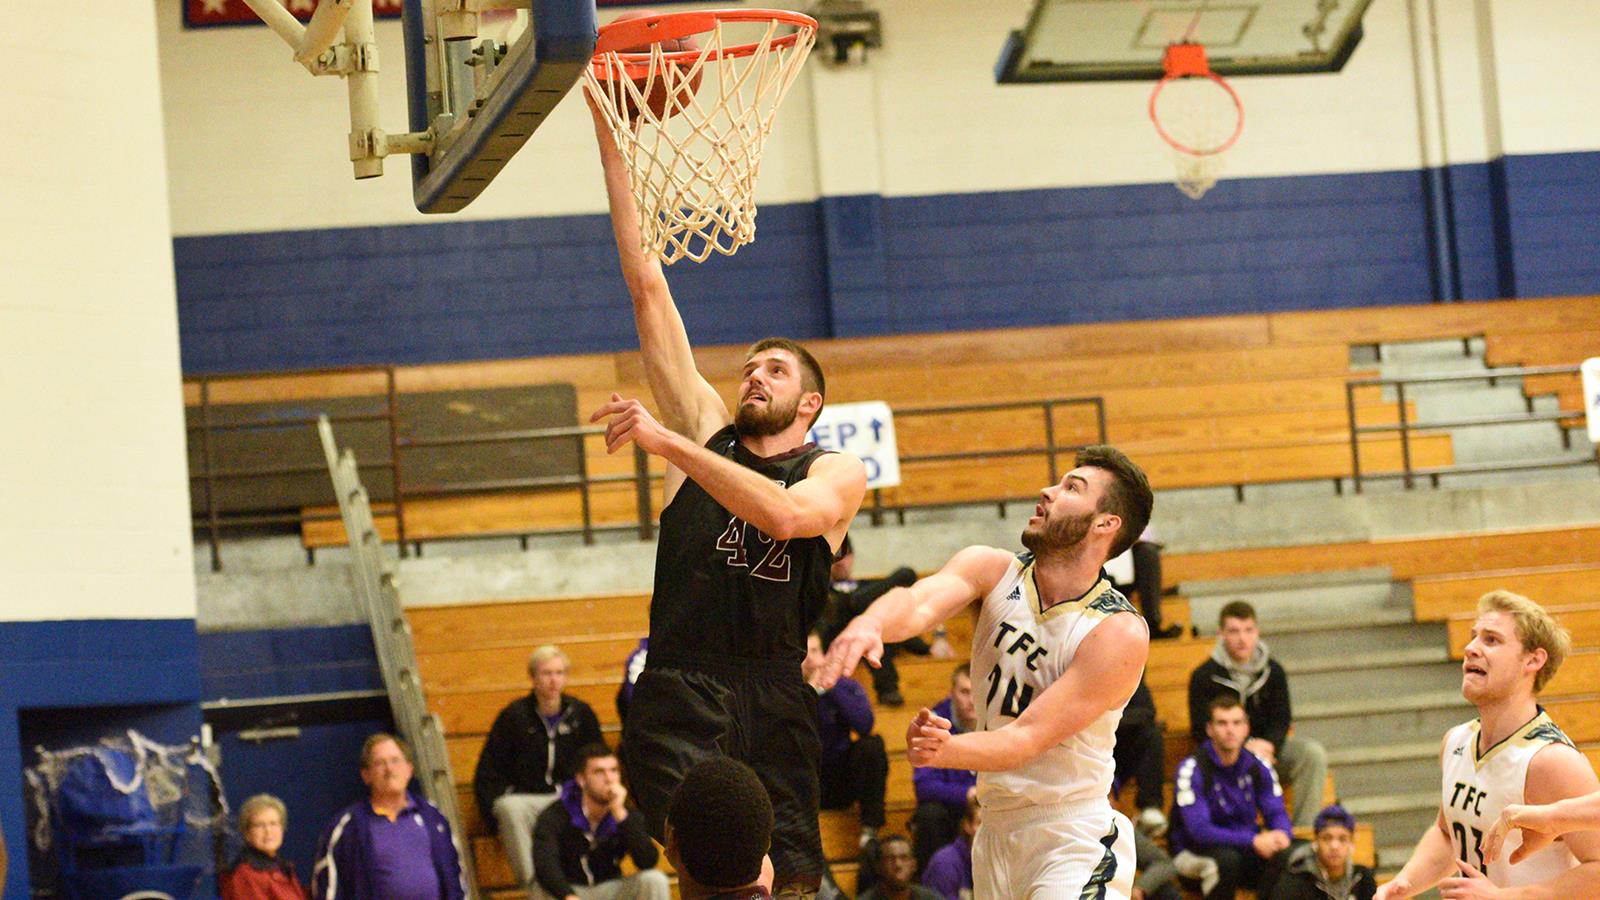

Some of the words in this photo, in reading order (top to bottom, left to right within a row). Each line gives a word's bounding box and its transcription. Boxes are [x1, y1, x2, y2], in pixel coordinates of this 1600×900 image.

[716, 515, 790, 582] 42
[993, 621, 1048, 672] TFC
[1450, 782, 1487, 818] TFC
